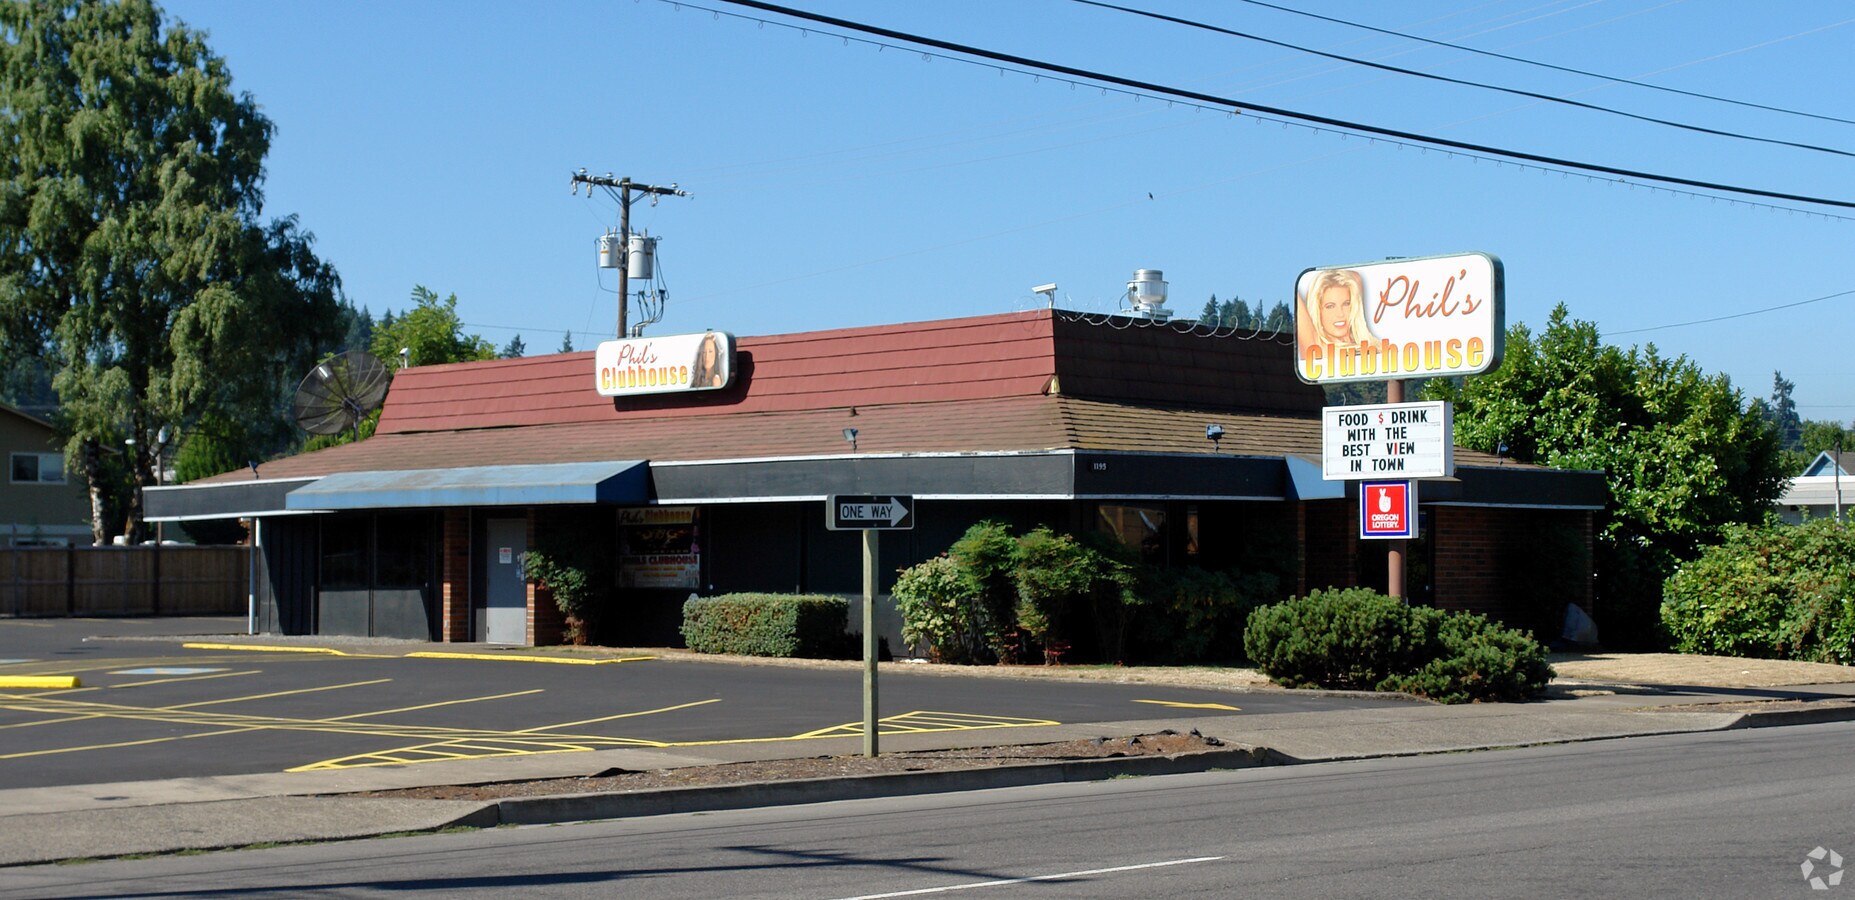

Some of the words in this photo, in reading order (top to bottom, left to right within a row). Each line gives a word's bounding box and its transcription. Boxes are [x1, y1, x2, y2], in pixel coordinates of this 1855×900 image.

[1374, 269, 1482, 324] Phil's
[618, 342, 657, 366] Phil's
[1305, 336, 1484, 379] Clubhouse
[601, 364, 688, 390] Clubhouse
[1338, 413, 1369, 427] FOOD
[1391, 410, 1428, 424] DRINK
[1347, 428, 1376, 441] WITH
[1385, 426, 1407, 440] THE
[1342, 443, 1371, 457] BEST
[1386, 442, 1415, 455] VIEW
[1350, 459, 1362, 472] IN
[1372, 458, 1404, 471] TOWN
[842, 505, 864, 519] ONE
[871, 505, 893, 519] WAY
[1371, 513, 1399, 521] OREGON
